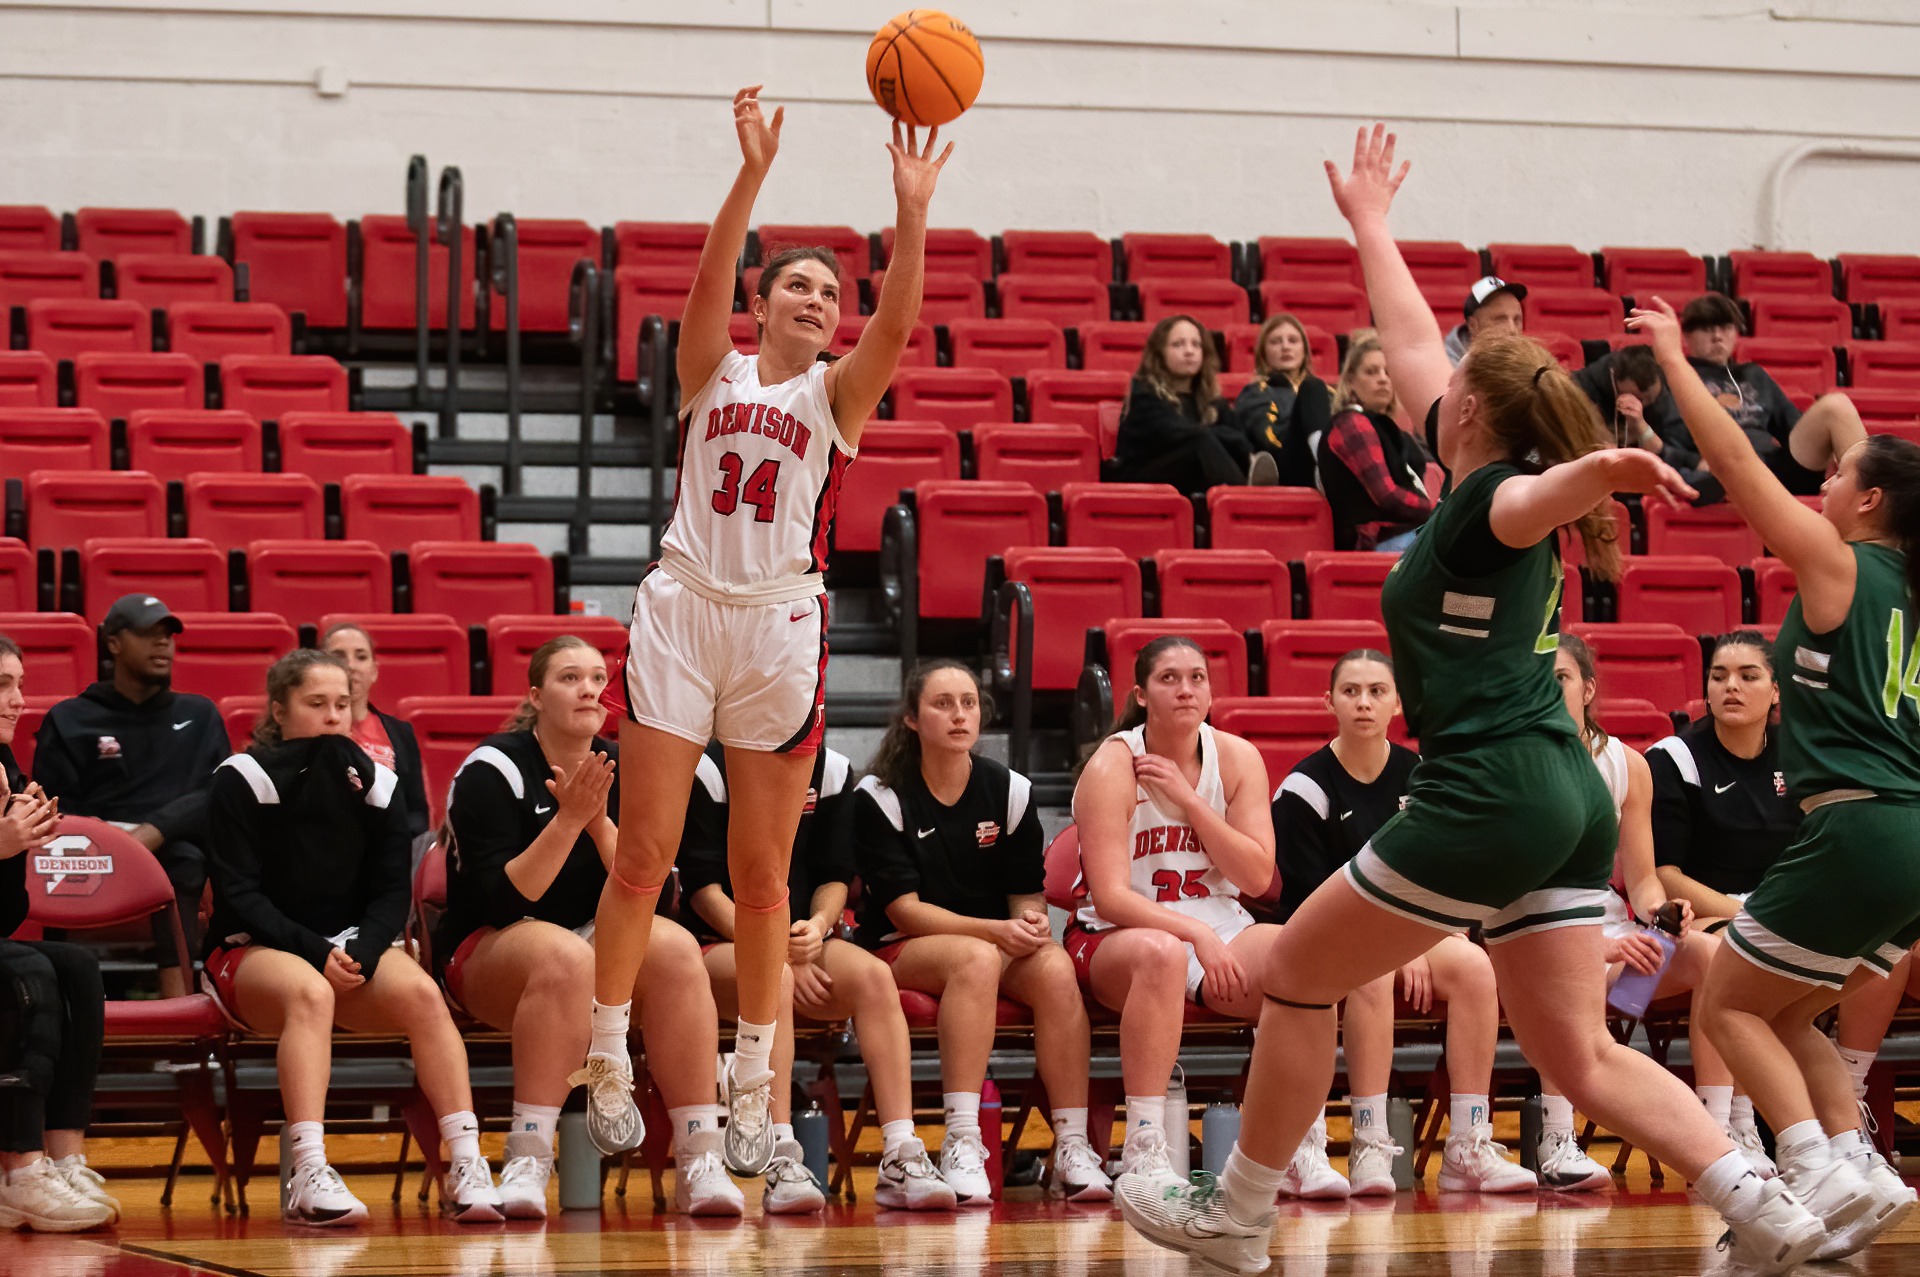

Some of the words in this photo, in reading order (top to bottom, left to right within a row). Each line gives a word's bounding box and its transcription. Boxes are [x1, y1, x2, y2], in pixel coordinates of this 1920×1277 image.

[705, 403, 812, 461] DENISON
[711, 451, 781, 523] 34
[38, 857, 109, 871] DENISON
[1132, 825, 1208, 861] DENIS
